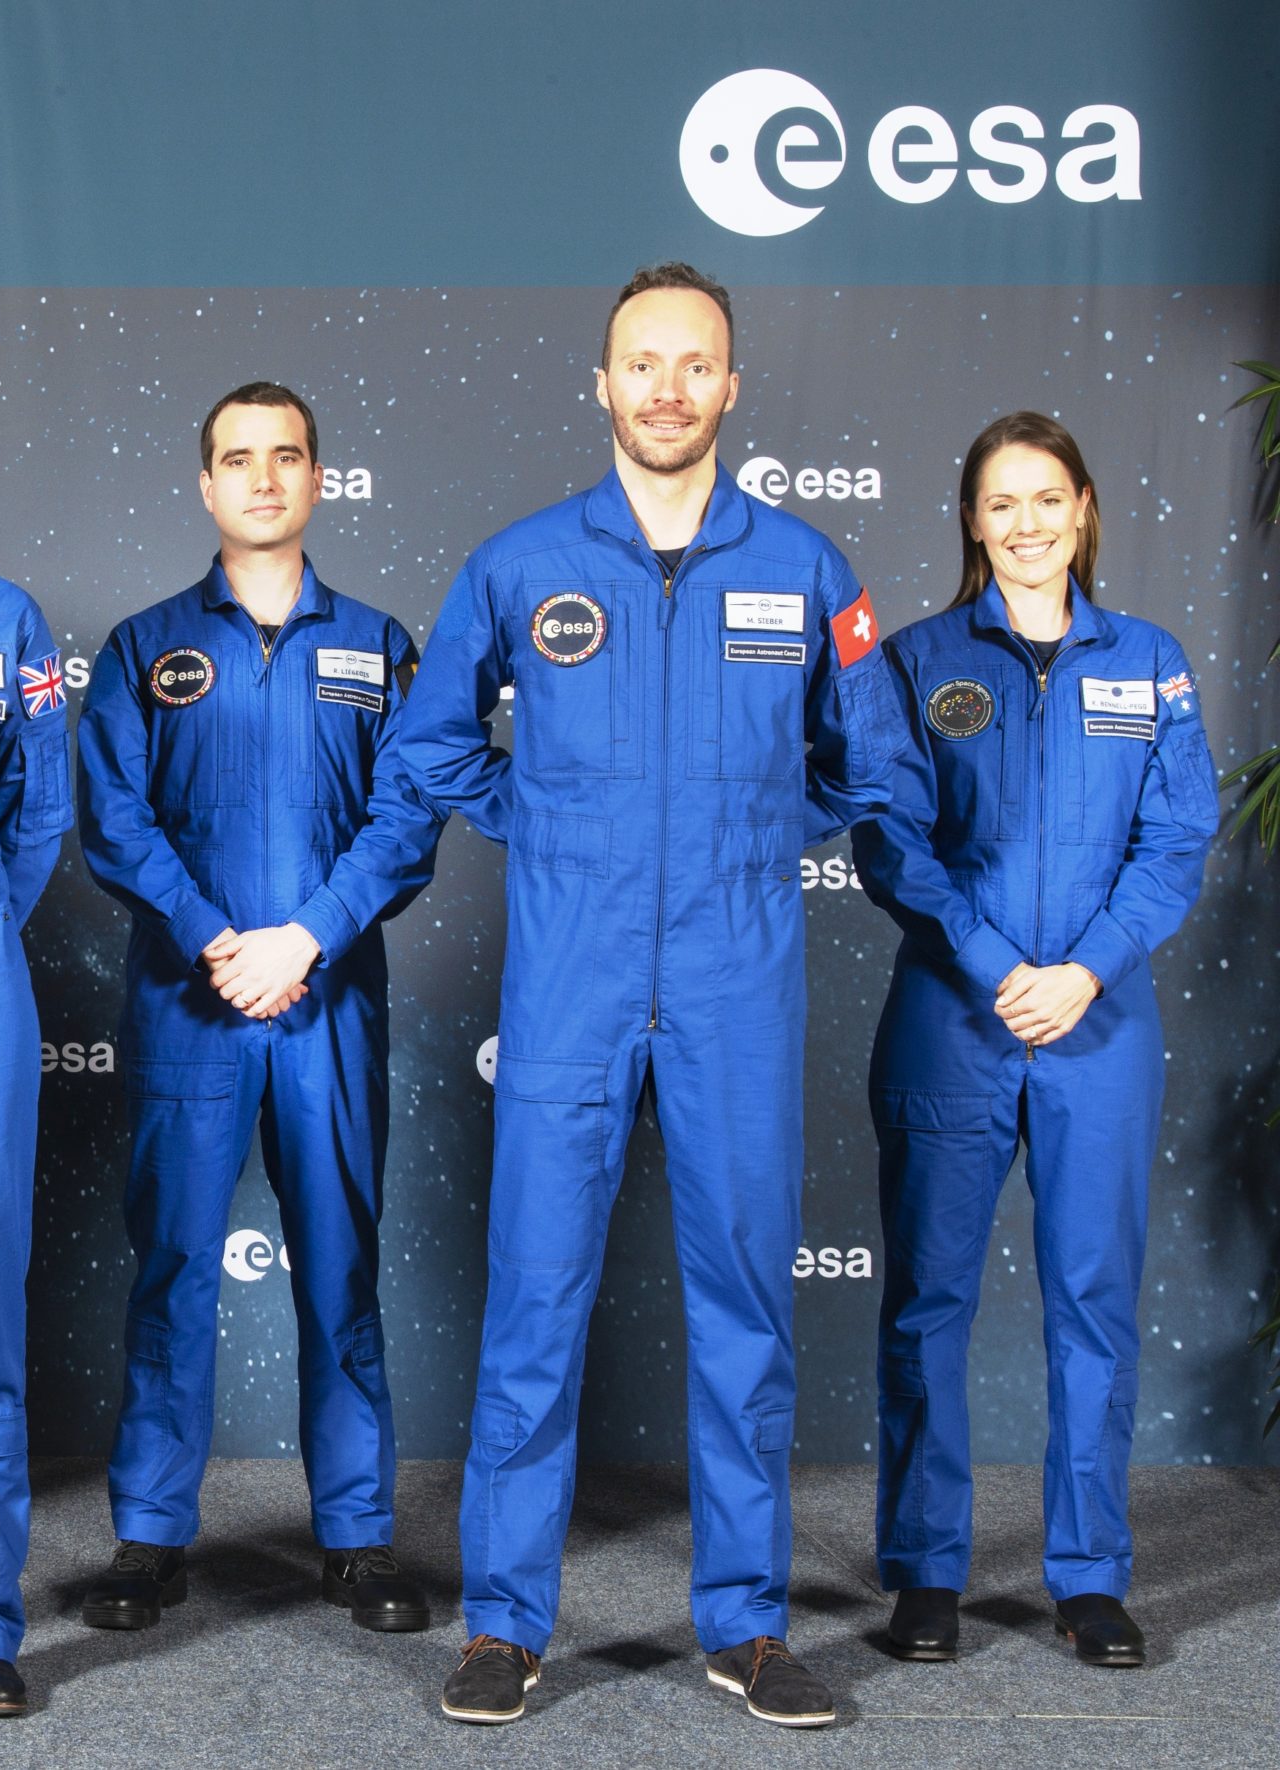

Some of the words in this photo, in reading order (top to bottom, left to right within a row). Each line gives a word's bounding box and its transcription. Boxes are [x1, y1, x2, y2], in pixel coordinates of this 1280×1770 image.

[868, 104, 1142, 204] esa
[321, 468, 372, 500] sa
[794, 467, 882, 500] esa
[563, 622, 594, 635] esa
[758, 617, 783, 625] SIEBER
[178, 670, 205, 681] esa
[791, 1246, 872, 1278] esa
